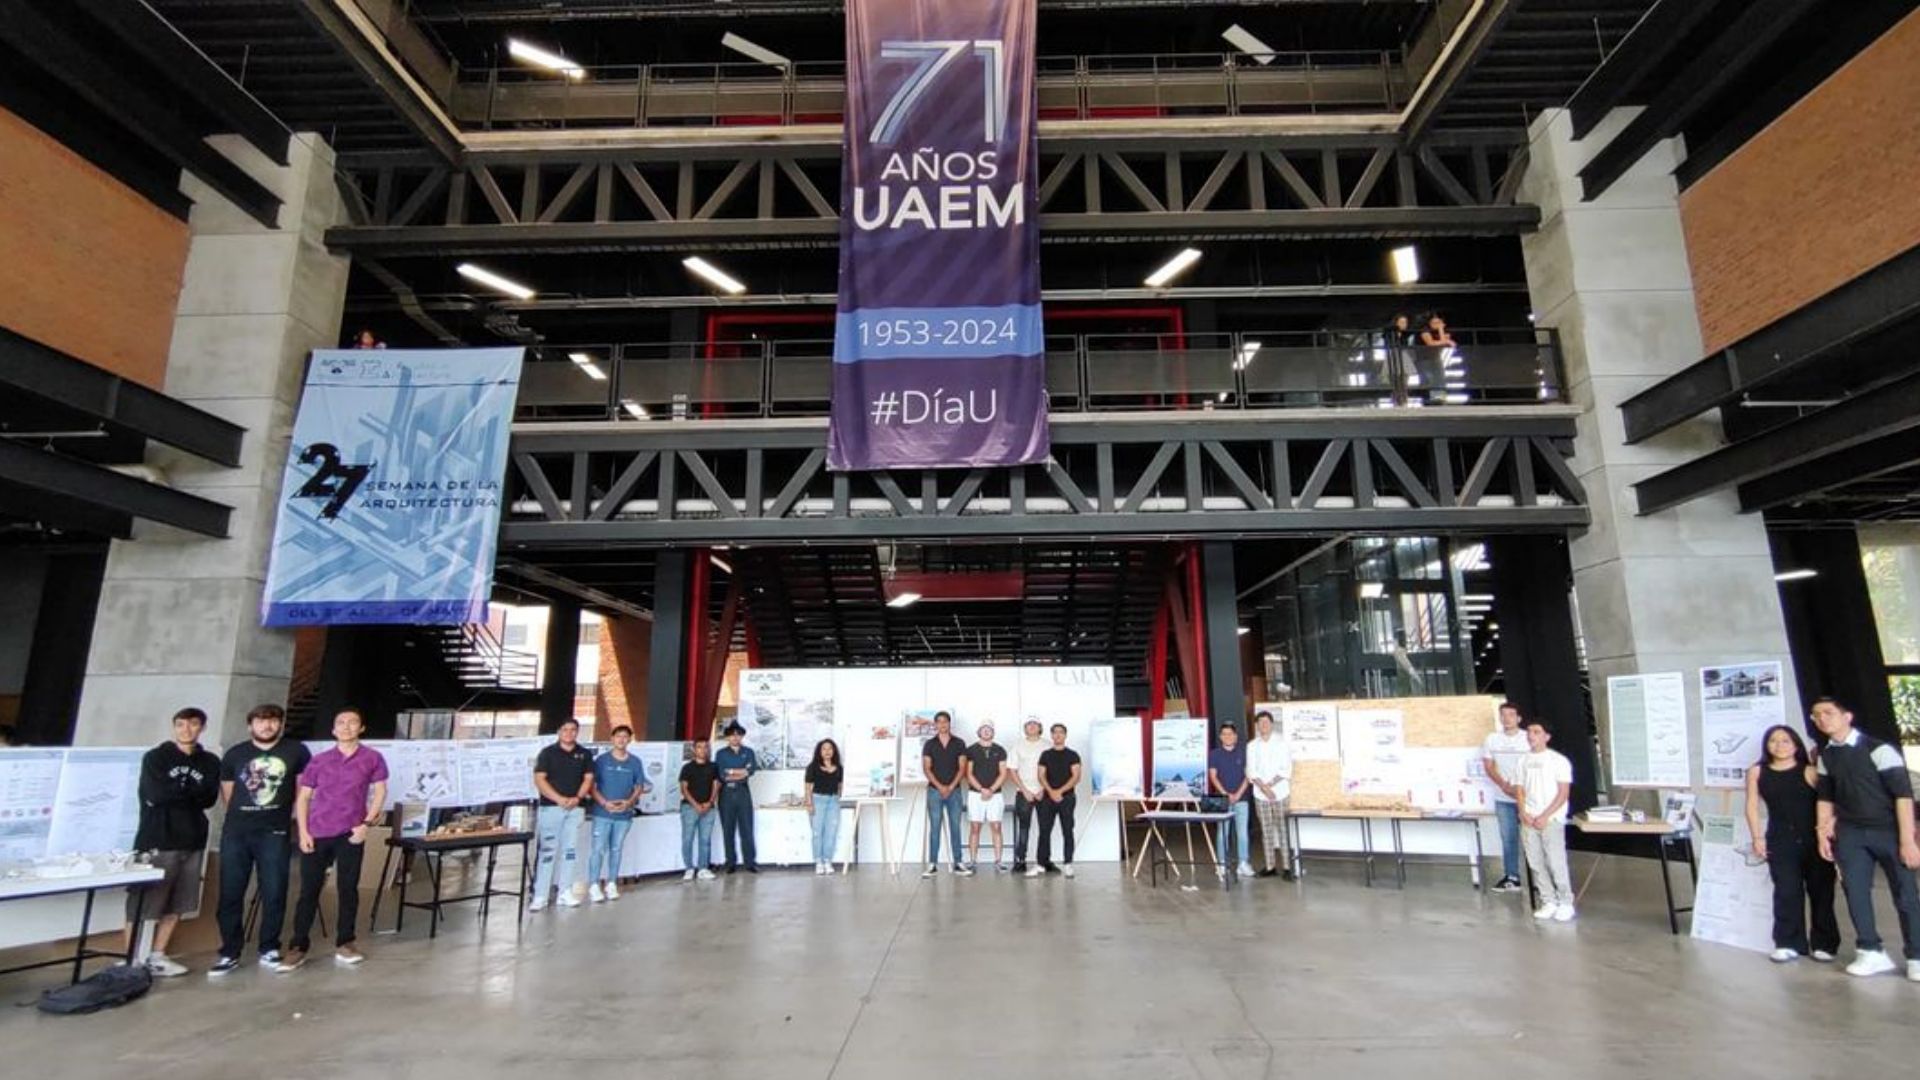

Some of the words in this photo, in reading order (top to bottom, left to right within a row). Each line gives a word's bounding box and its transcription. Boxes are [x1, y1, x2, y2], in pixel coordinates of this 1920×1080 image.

[869, 40, 1007, 143] 71
[881, 147, 998, 182] AÑOS
[853, 182, 1024, 231] UAEM
[858, 317, 1018, 347] 1953-2024
[871, 389, 998, 426] #DíaU
[290, 442, 377, 521] 27
[366, 480, 439, 491] SEMANA
[447, 480, 470, 490] DE
[478, 480, 498, 490] LA
[360, 498, 498, 510] ARQUITECTURA
